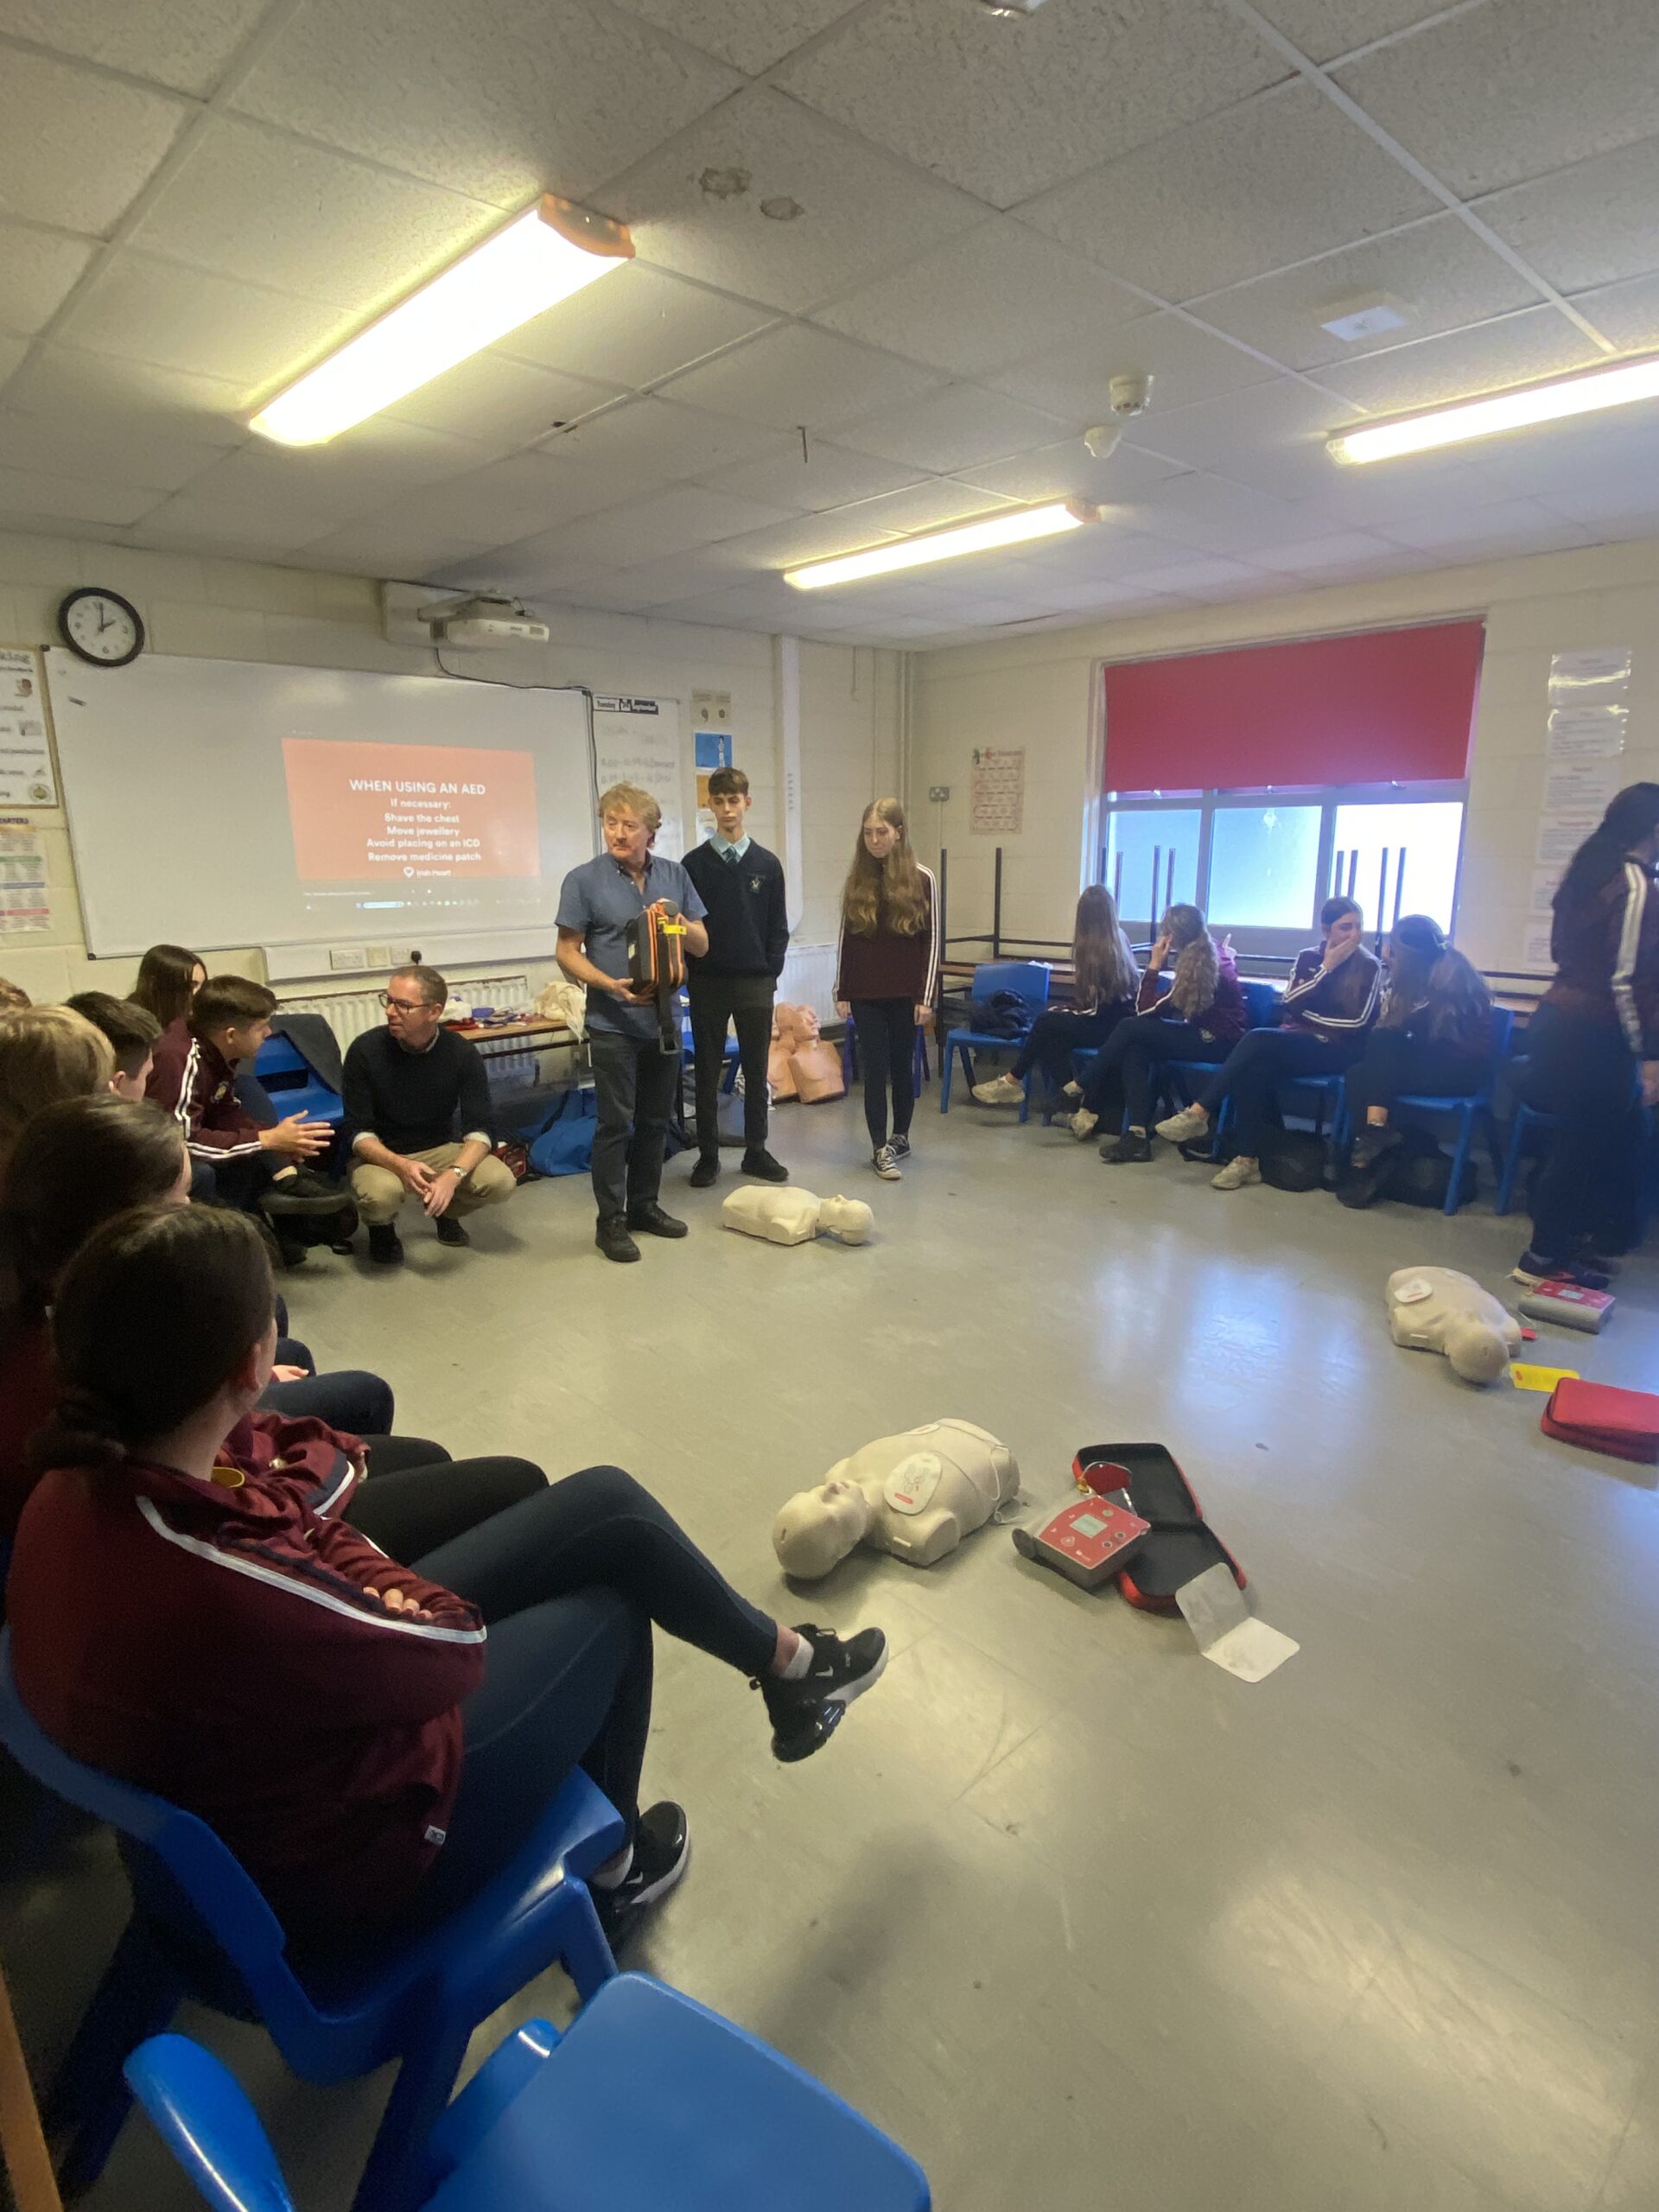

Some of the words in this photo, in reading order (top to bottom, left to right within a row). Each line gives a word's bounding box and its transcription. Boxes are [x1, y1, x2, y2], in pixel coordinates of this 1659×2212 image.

[349, 779, 392, 792] WHEN
[396, 781, 436, 793] USING
[439, 783, 458, 794] AN
[461, 784, 486, 795] AED
[391, 798, 398, 807] If
[400, 800, 451, 810] necessary:
[385, 812, 414, 822] Shave
[416, 814, 432, 823] the
[434, 814, 460, 823] chest
[386, 826, 415, 836] Move
[416, 827, 460, 837] jewellery
[366, 838, 395, 848] Avoid
[397, 839, 433, 849] placing
[462, 838, 480, 848] ICD
[367, 852, 408, 861] Remove
[410, 852, 454, 861] medicine
[455, 852, 482, 862] patch
